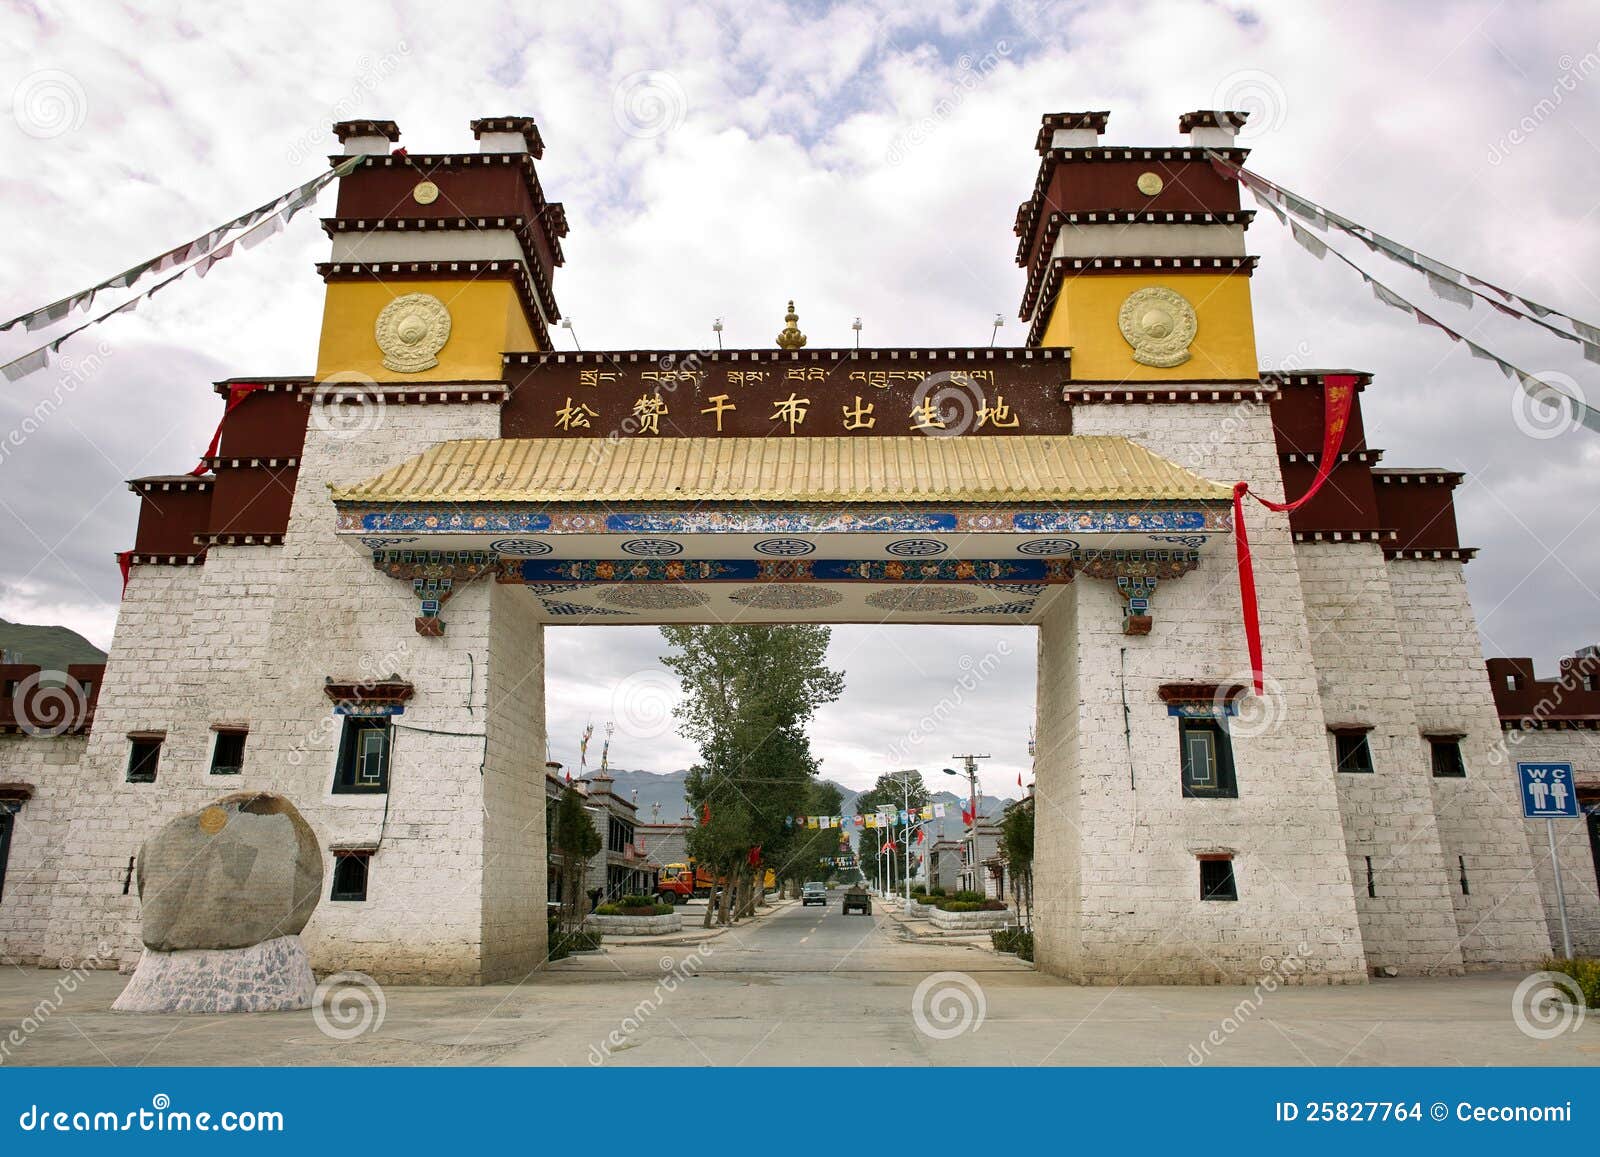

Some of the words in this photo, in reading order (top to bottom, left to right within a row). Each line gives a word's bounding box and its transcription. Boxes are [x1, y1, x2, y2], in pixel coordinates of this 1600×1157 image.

[555, 392, 1020, 435] 松赞干布出生地
[1527, 769, 1566, 779] WC
